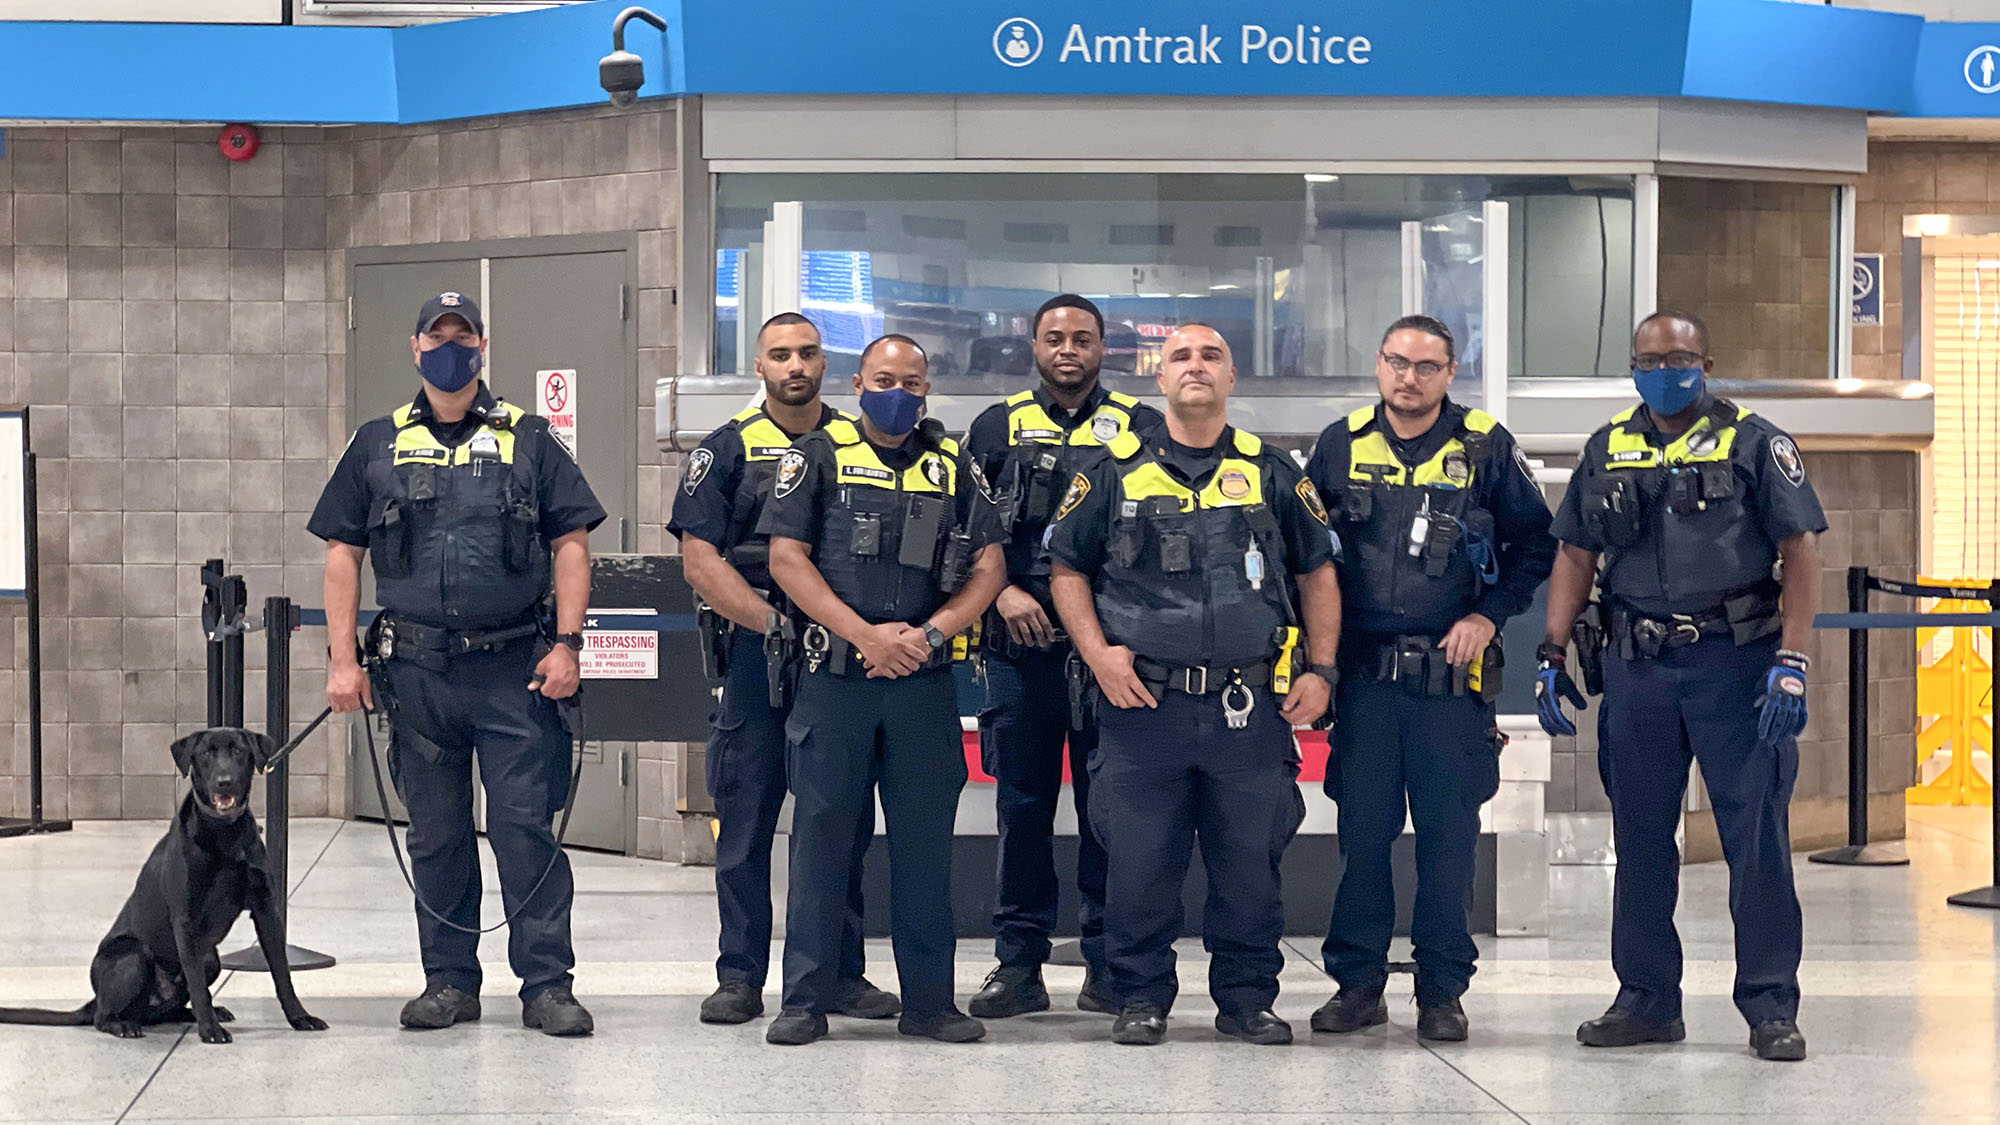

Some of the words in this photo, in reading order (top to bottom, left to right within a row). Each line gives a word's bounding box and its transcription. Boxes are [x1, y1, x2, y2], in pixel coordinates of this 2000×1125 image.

[1059, 23, 1223, 64] Amtrak
[1240, 24, 1373, 65] Police
[1124, 505, 1135, 513] TQ
[586, 636, 655, 648] TRESPASSING
[594, 652, 629, 660] VIOLATORS
